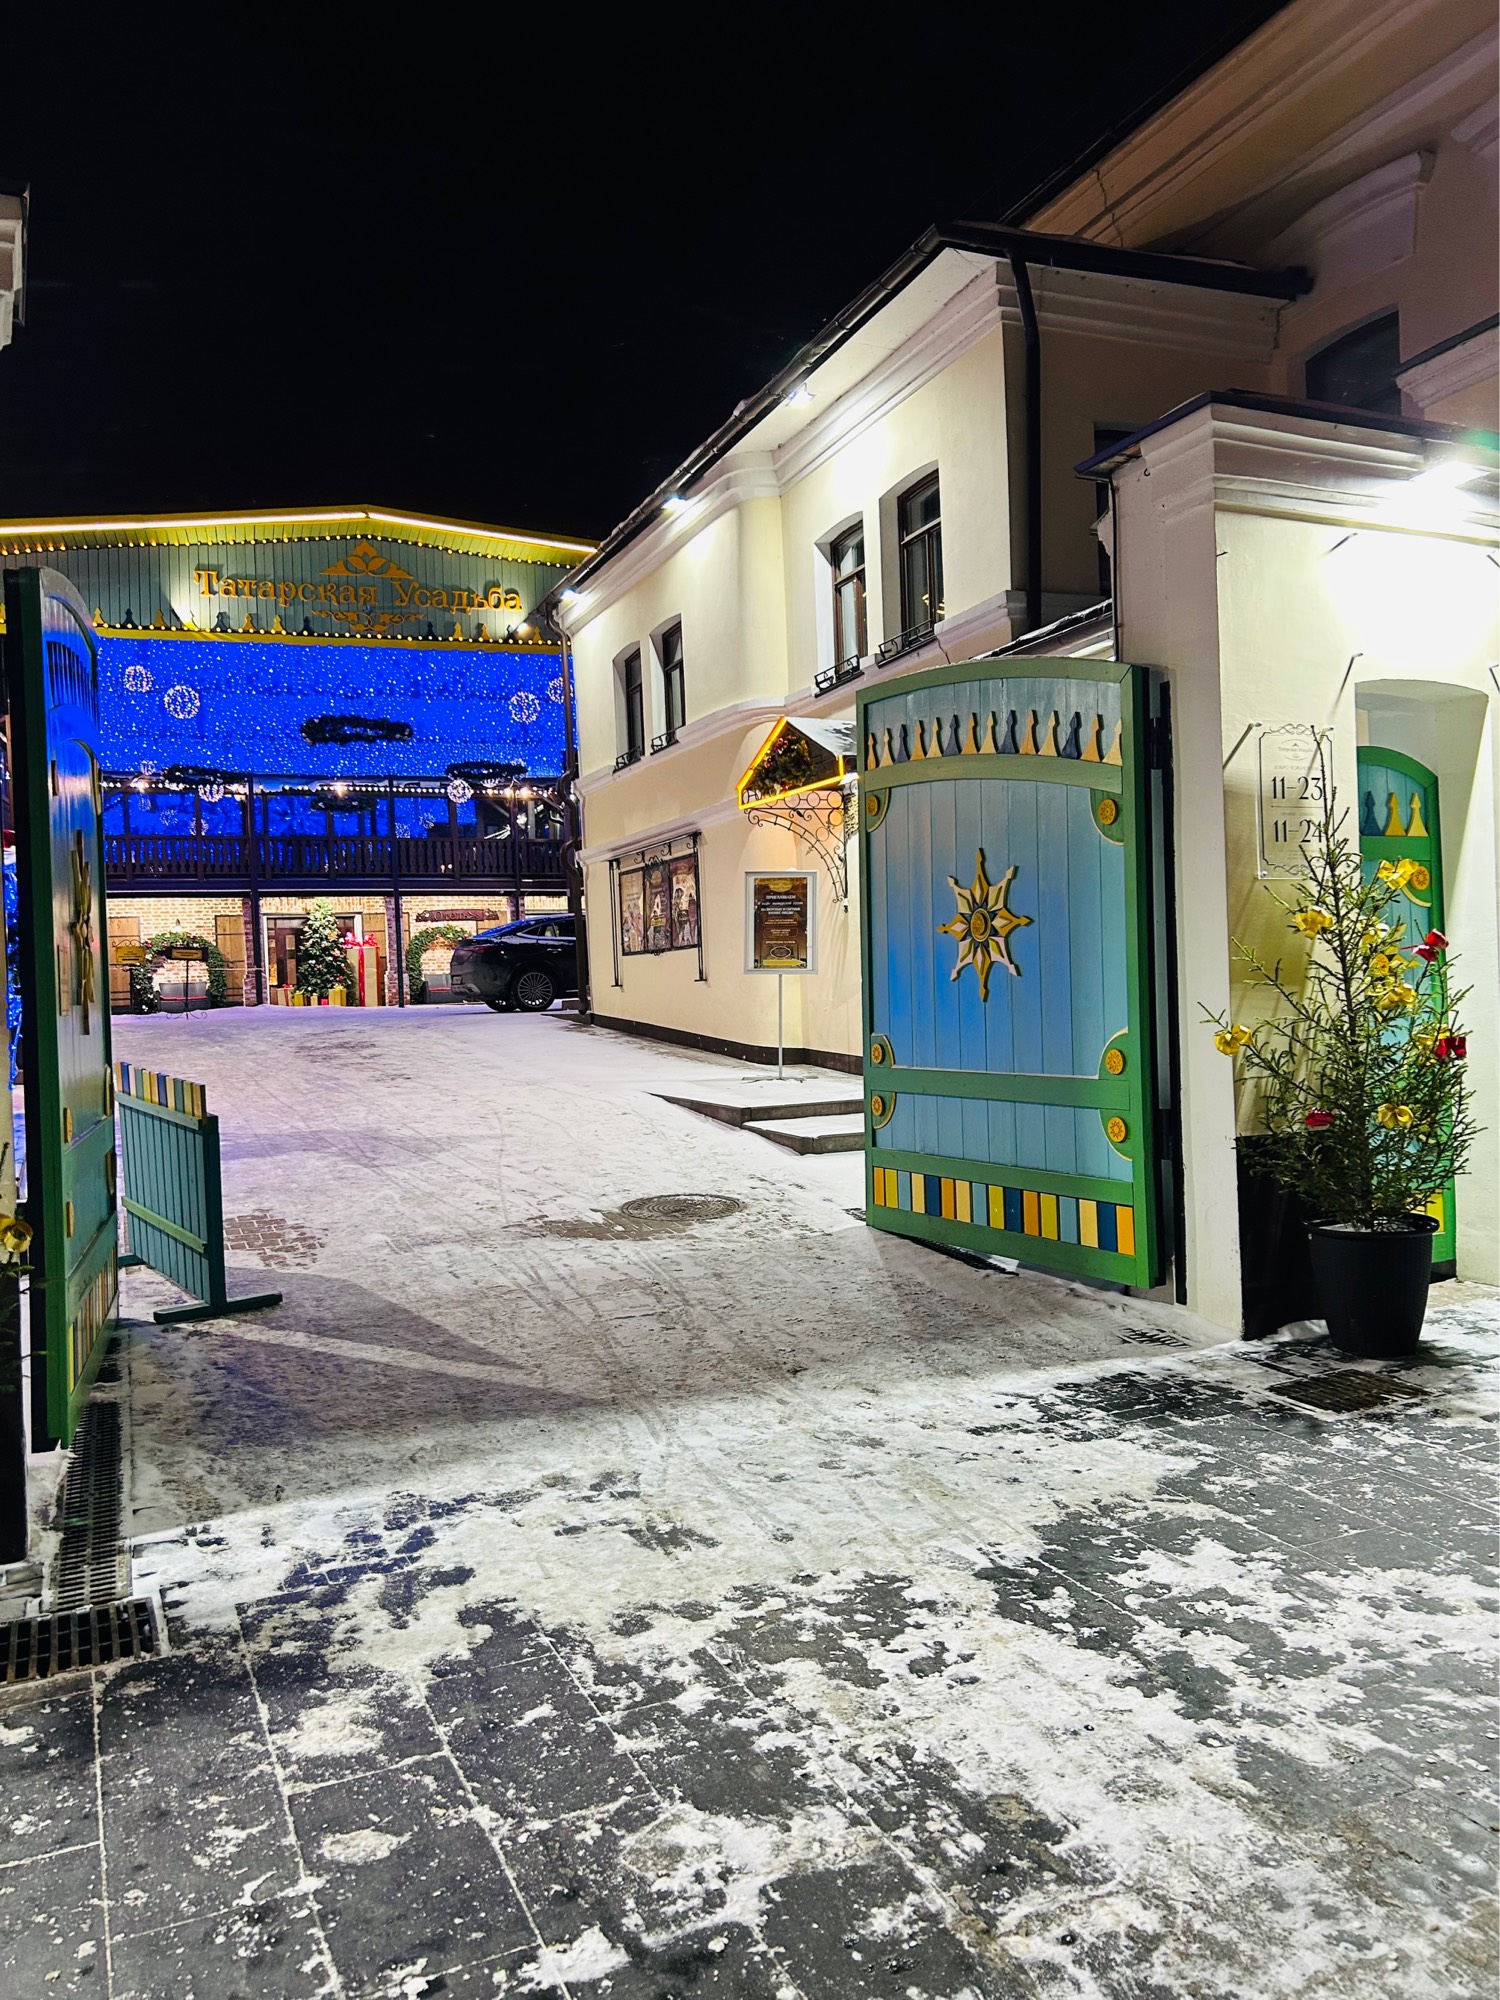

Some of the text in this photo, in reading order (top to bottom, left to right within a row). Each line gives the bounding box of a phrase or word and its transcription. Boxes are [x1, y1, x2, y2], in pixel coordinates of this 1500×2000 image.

[193, 569, 523, 615] Татарская Усадьба
[1271, 775, 1323, 801] 11-23
[1273, 818, 1326, 843] 11-24
